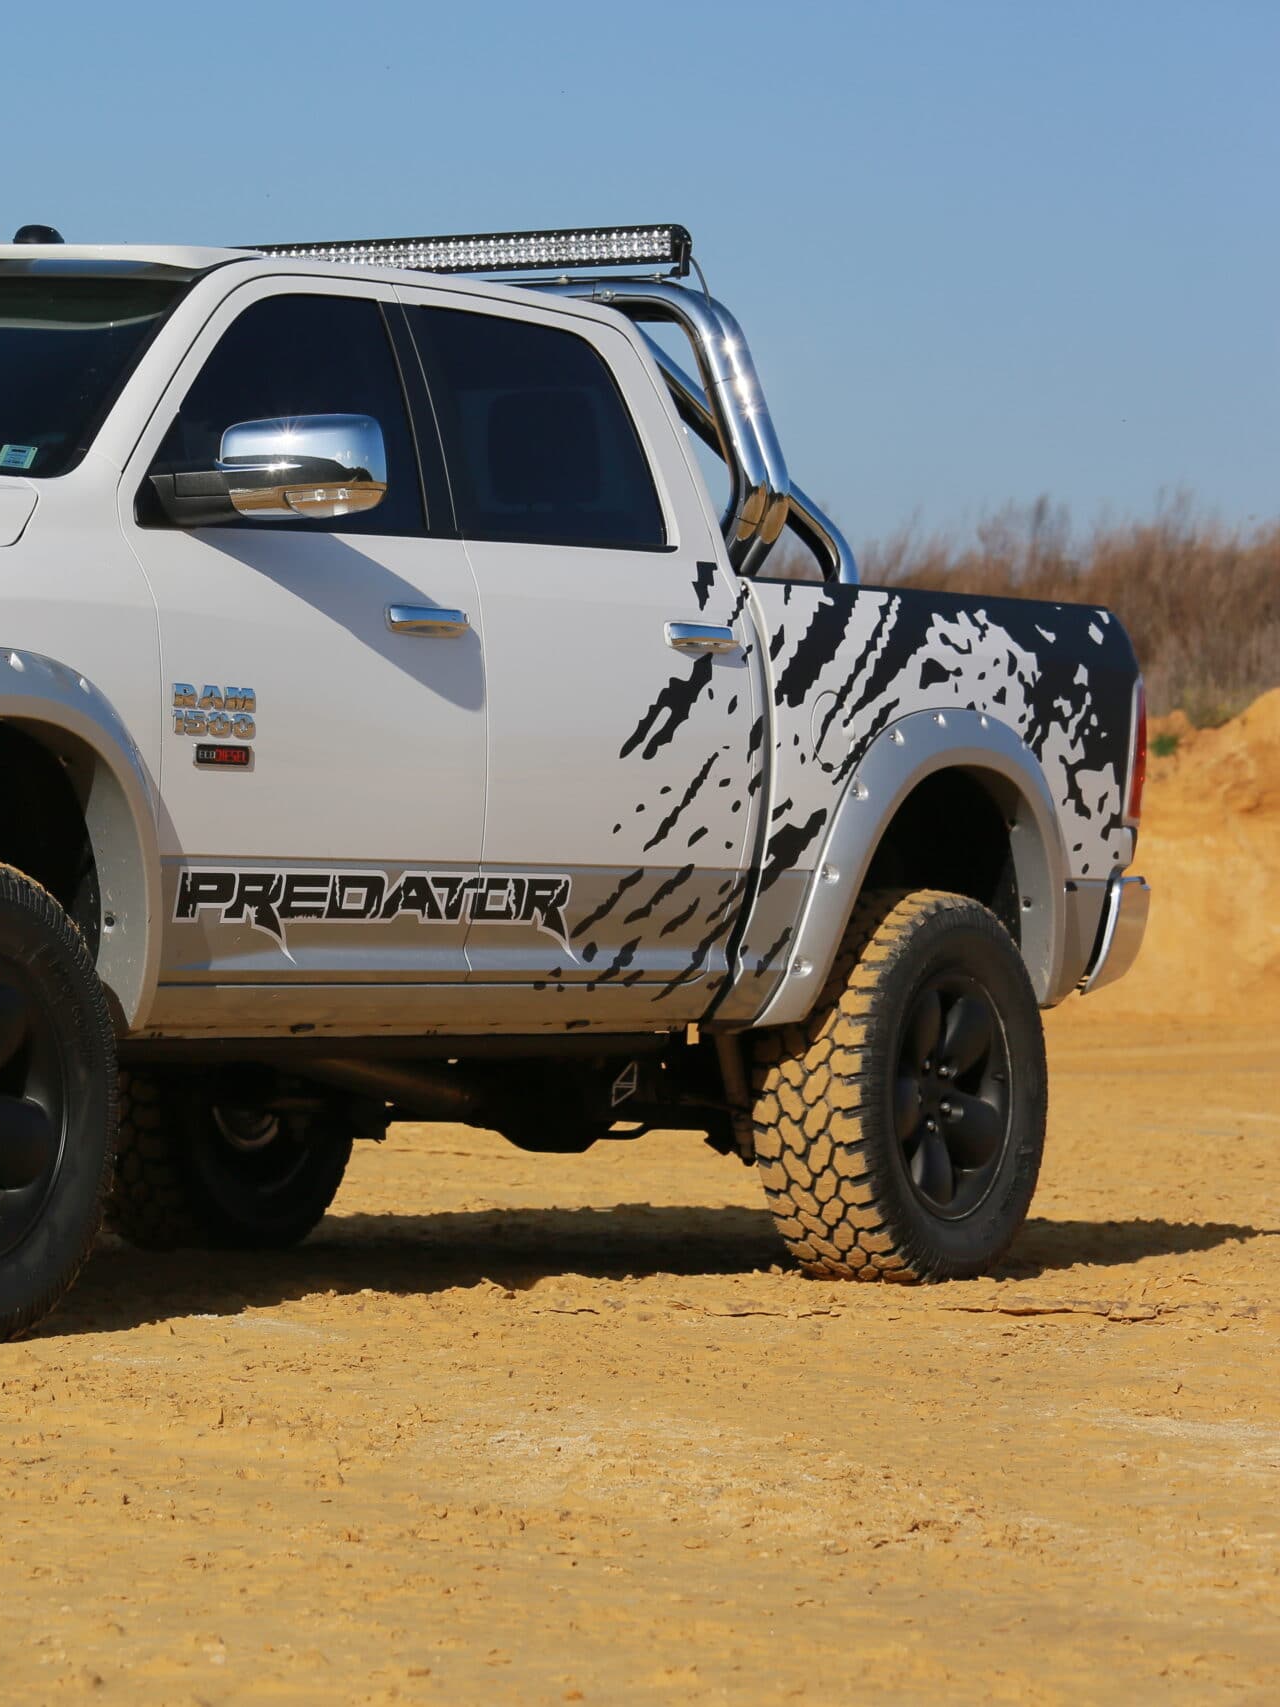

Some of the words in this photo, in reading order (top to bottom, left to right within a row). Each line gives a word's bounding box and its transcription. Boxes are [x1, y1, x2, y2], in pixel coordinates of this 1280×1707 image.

[172, 683, 256, 713] RAM
[172, 709, 256, 740] 1500
[172, 866, 580, 962] PREDATOR
